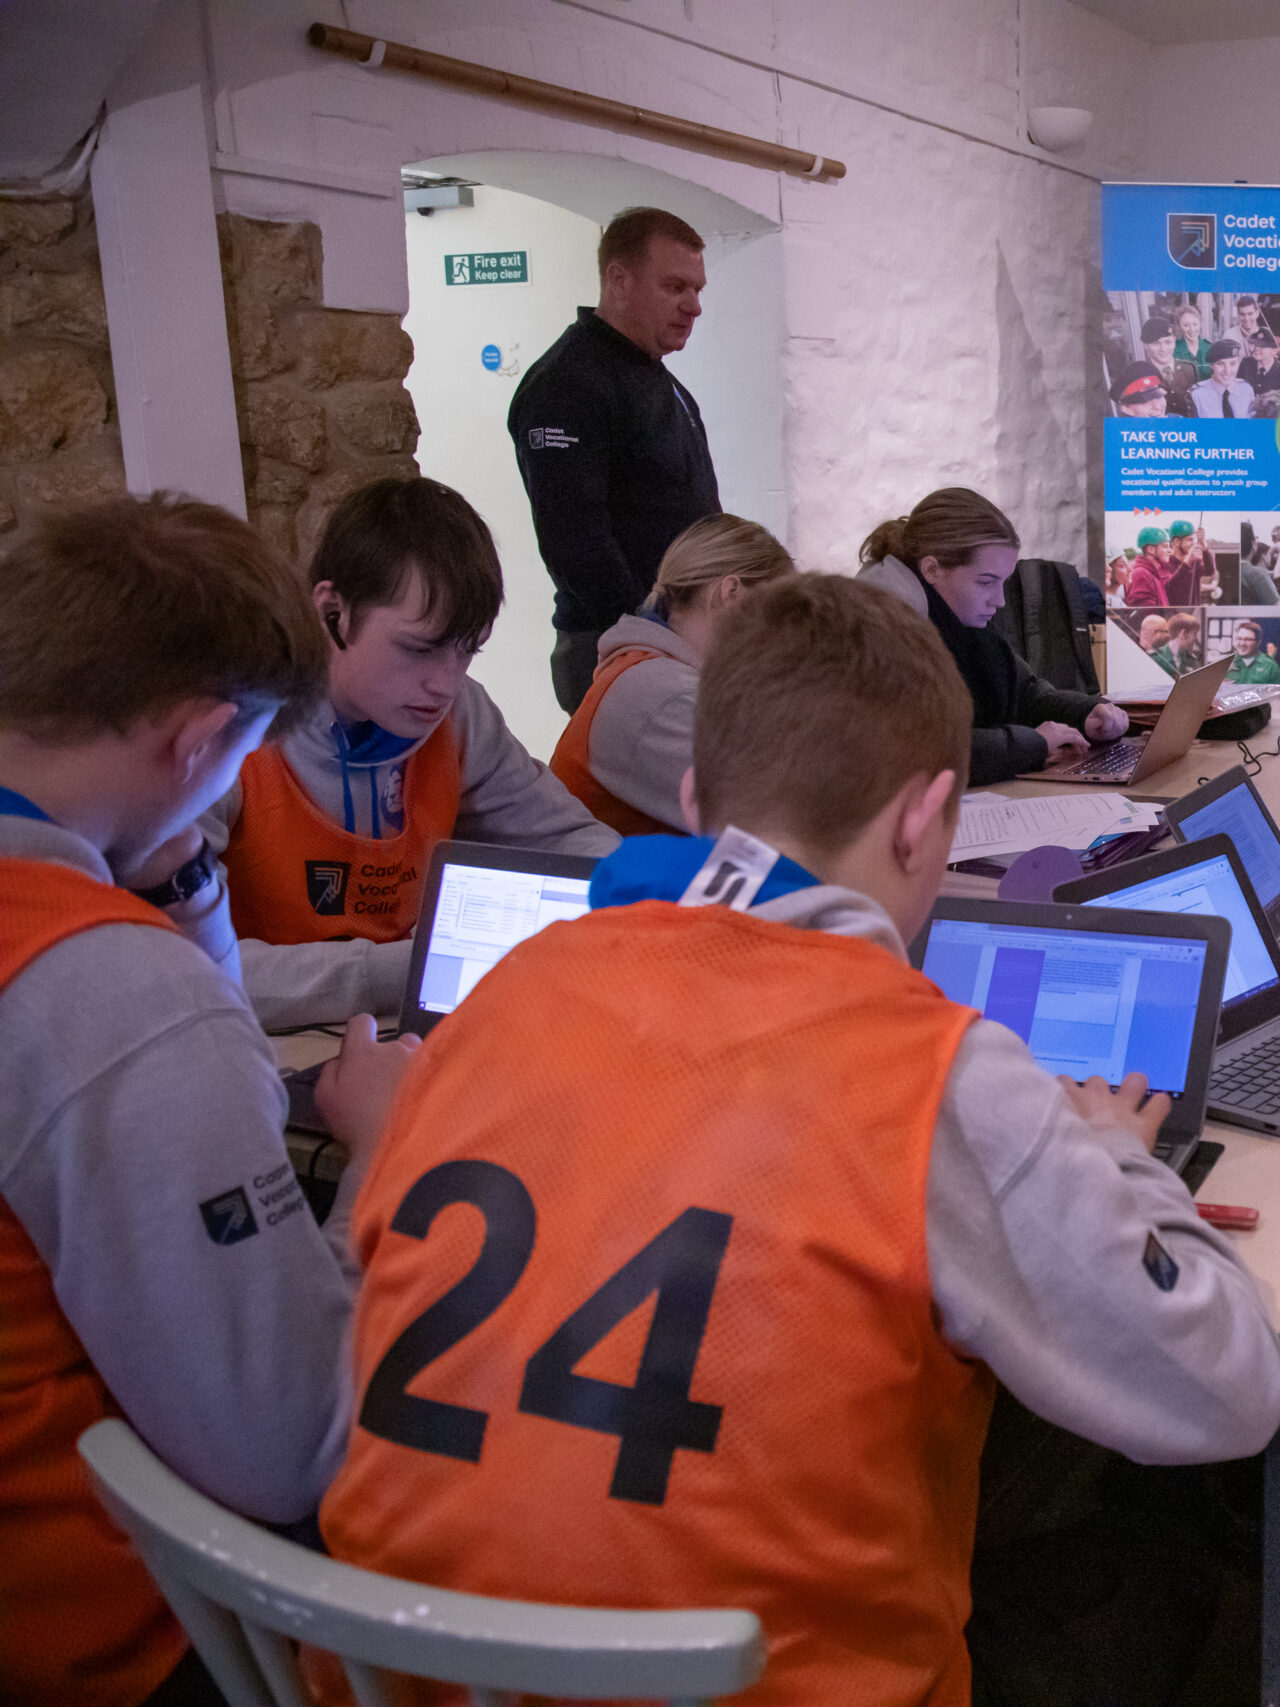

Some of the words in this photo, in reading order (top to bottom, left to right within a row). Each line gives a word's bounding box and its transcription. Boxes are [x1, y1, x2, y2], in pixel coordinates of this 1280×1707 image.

[1224, 214, 1276, 229] Cadet
[474, 256, 497, 268] Fire
[500, 253, 521, 267] exit
[475, 270, 498, 281] Keep
[500, 269, 521, 279] clear
[545, 434, 579, 443] Vocational
[1120, 431, 1155, 443] TAKE
[1159, 431, 1198, 443] YOUR
[545, 441, 569, 449] College
[1121, 448, 1190, 460] LEARNING
[1194, 448, 1255, 460] FURTHER
[1121, 467, 1144, 476] Cadet
[1146, 467, 1185, 476] Vocational
[1186, 467, 1215, 478] College
[1216, 468, 1248, 477] provides
[1161, 479, 1210, 487] qualifications
[1222, 479, 1244, 487] youth
[1245, 480, 1268, 488] group
[1174, 488, 1193, 496] adult
[1194, 489, 1236, 497] instructors
[358, 1160, 734, 1507] 24
